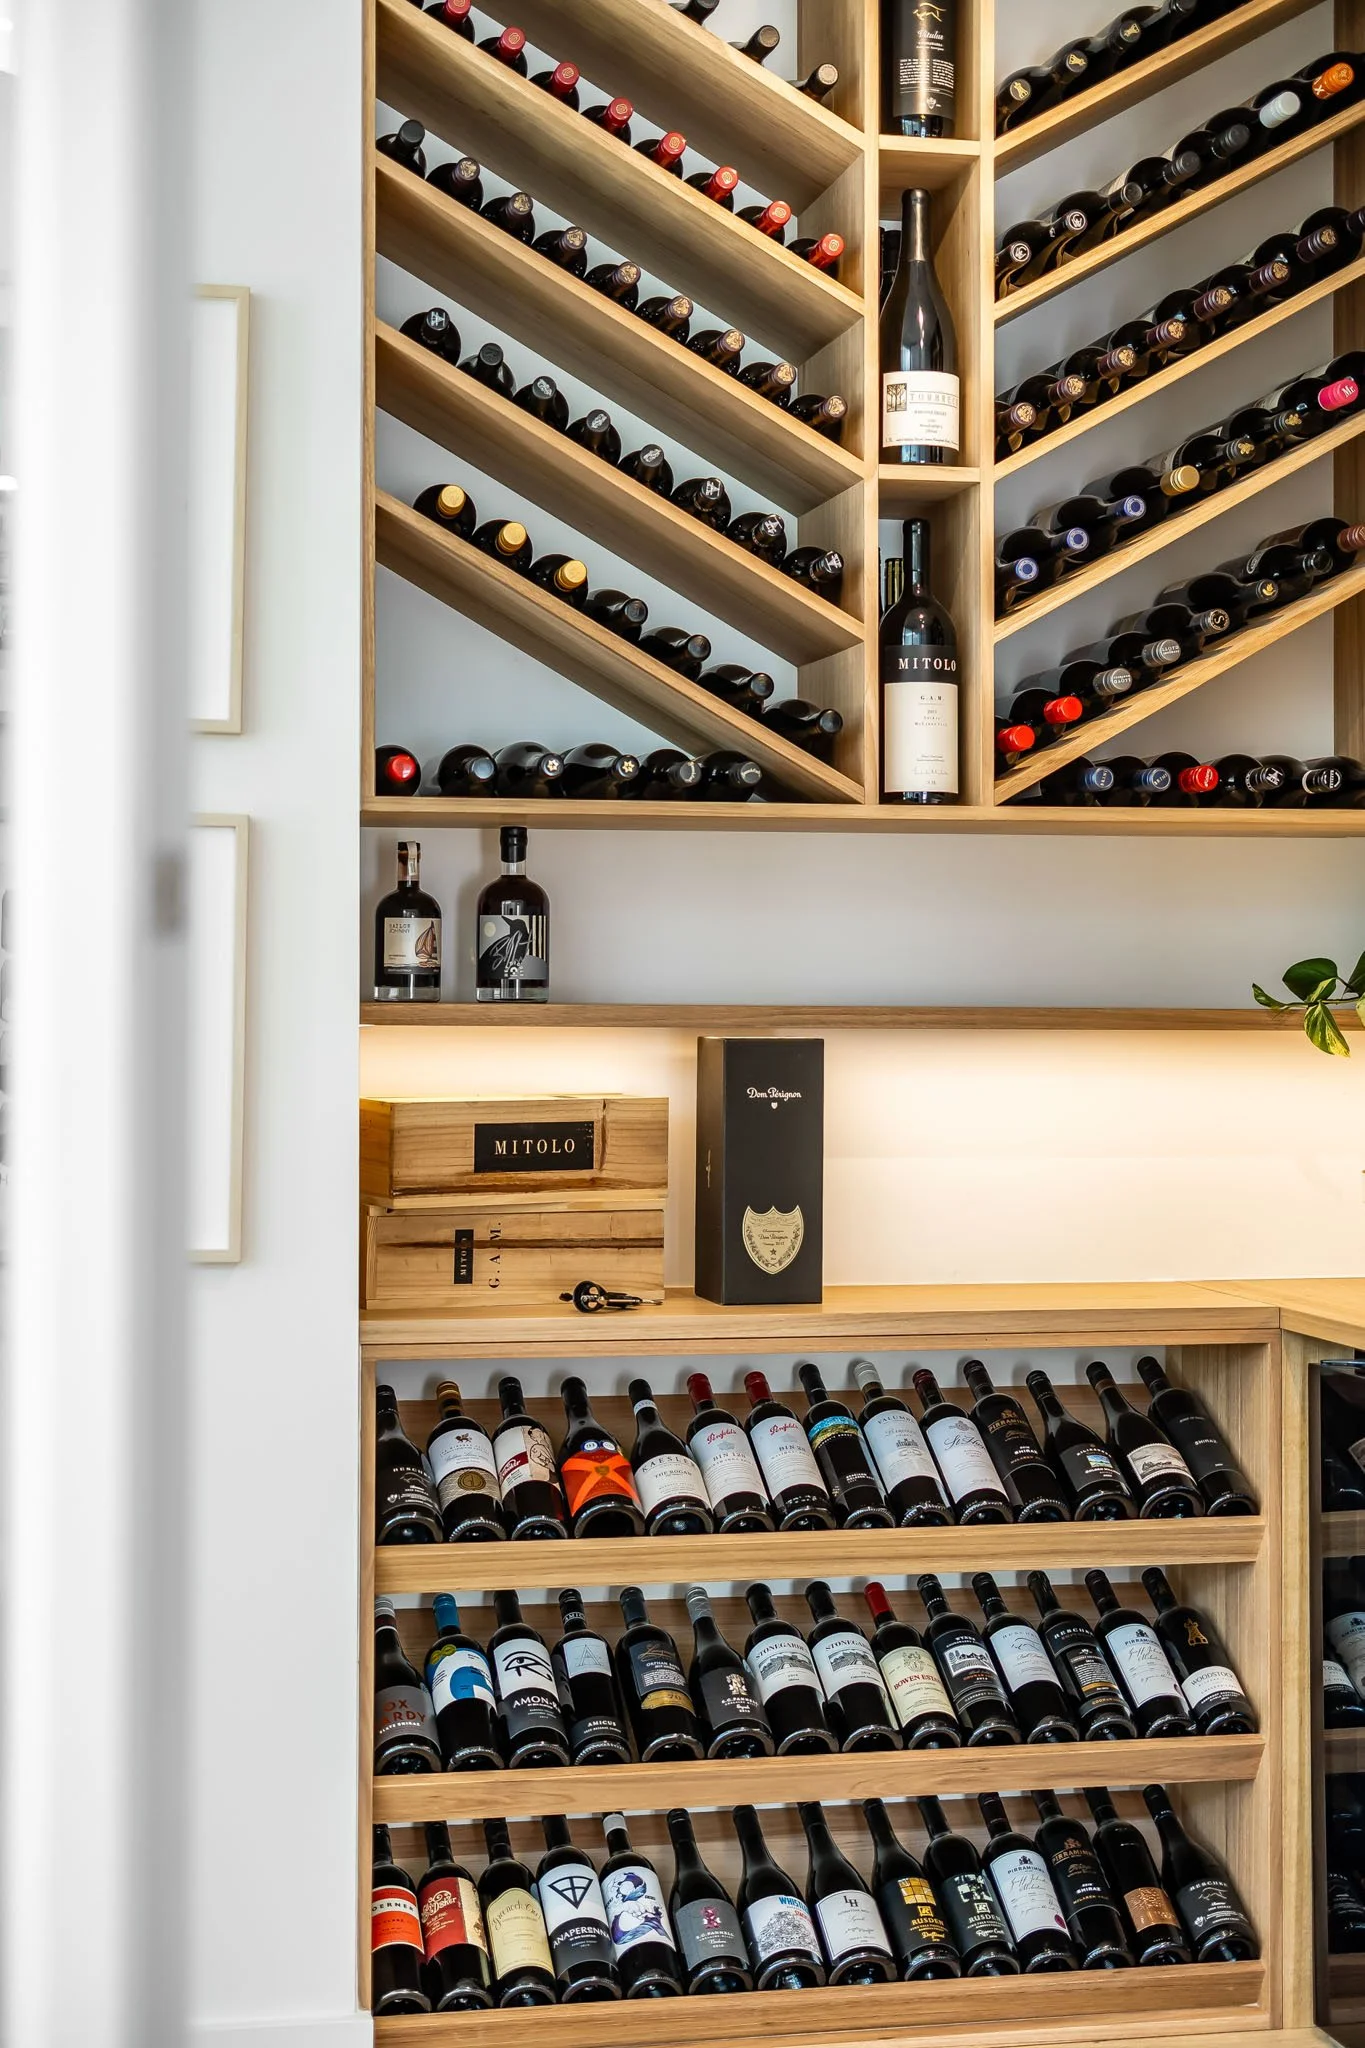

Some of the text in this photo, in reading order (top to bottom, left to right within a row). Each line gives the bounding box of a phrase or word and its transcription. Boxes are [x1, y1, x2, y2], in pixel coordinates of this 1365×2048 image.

[898, 657, 957, 672] MITOLO
[747, 1087, 802, 1101] Dom Pérignon
[494, 1138, 576, 1155] MITOLO
[893, 1674, 920, 1690] BOWEN
[1190, 1671, 1233, 1686] WOODSTOCK
[1076, 1886, 1101, 1894] SHIRAZ
[912, 1917, 945, 1926] RUSDEN
[968, 1914, 1002, 1923] RUSDEN
